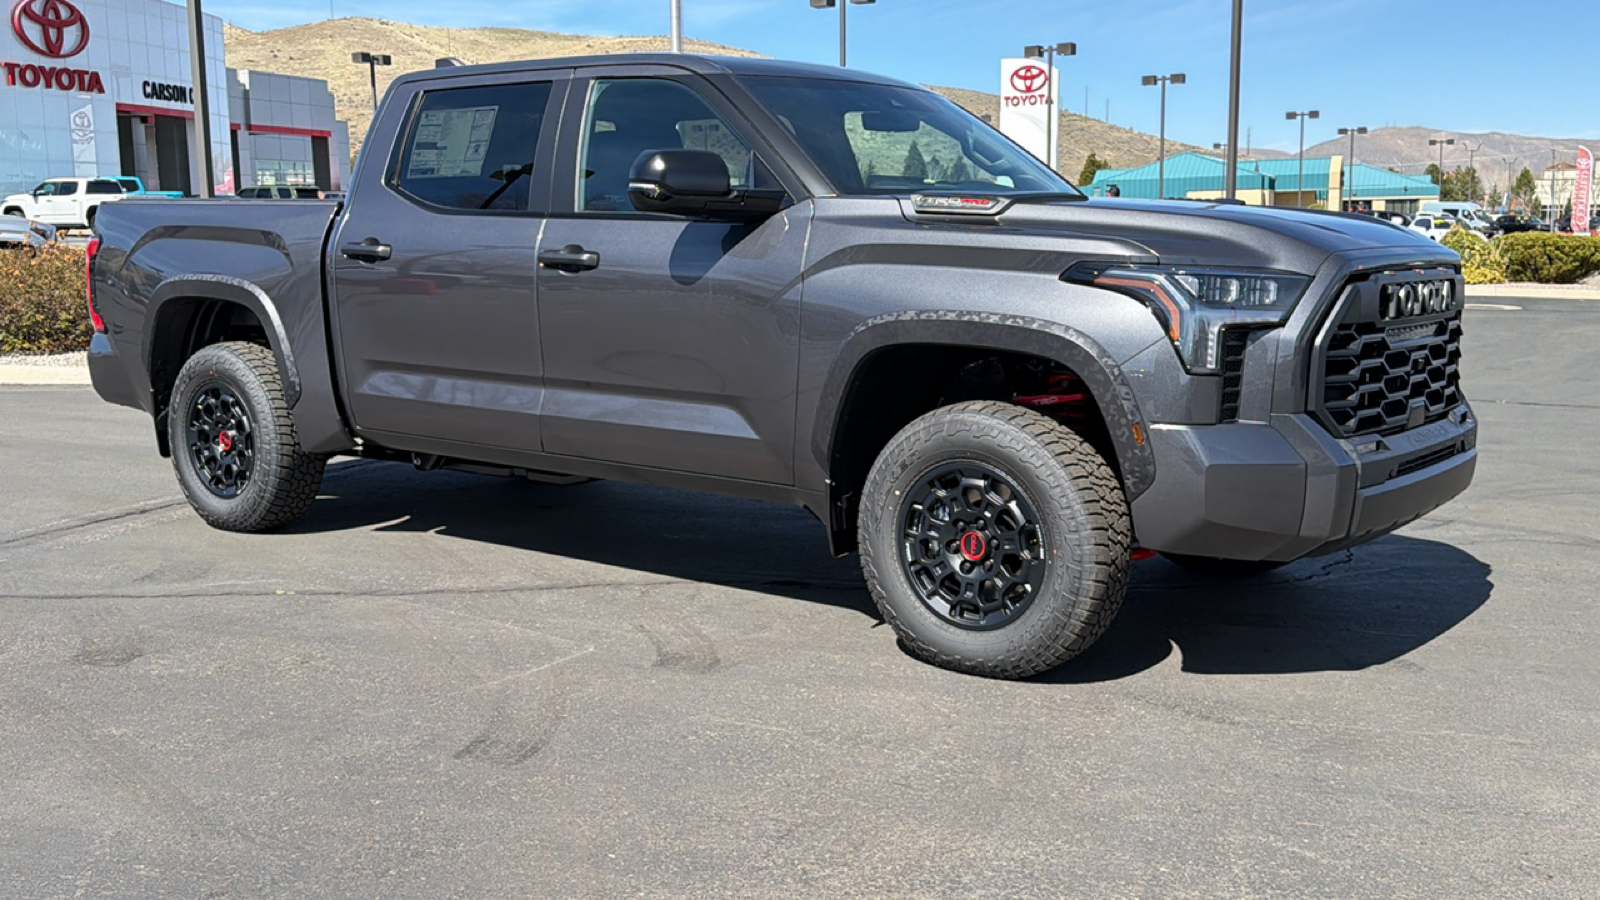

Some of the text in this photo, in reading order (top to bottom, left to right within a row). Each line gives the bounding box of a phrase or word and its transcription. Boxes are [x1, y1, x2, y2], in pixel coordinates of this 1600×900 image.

[2, 62, 105, 94] TOYOTA
[142, 80, 187, 104] CARSON
[1004, 96, 1054, 106] TOYOTA
[1387, 280, 1452, 318] TOYOTA
